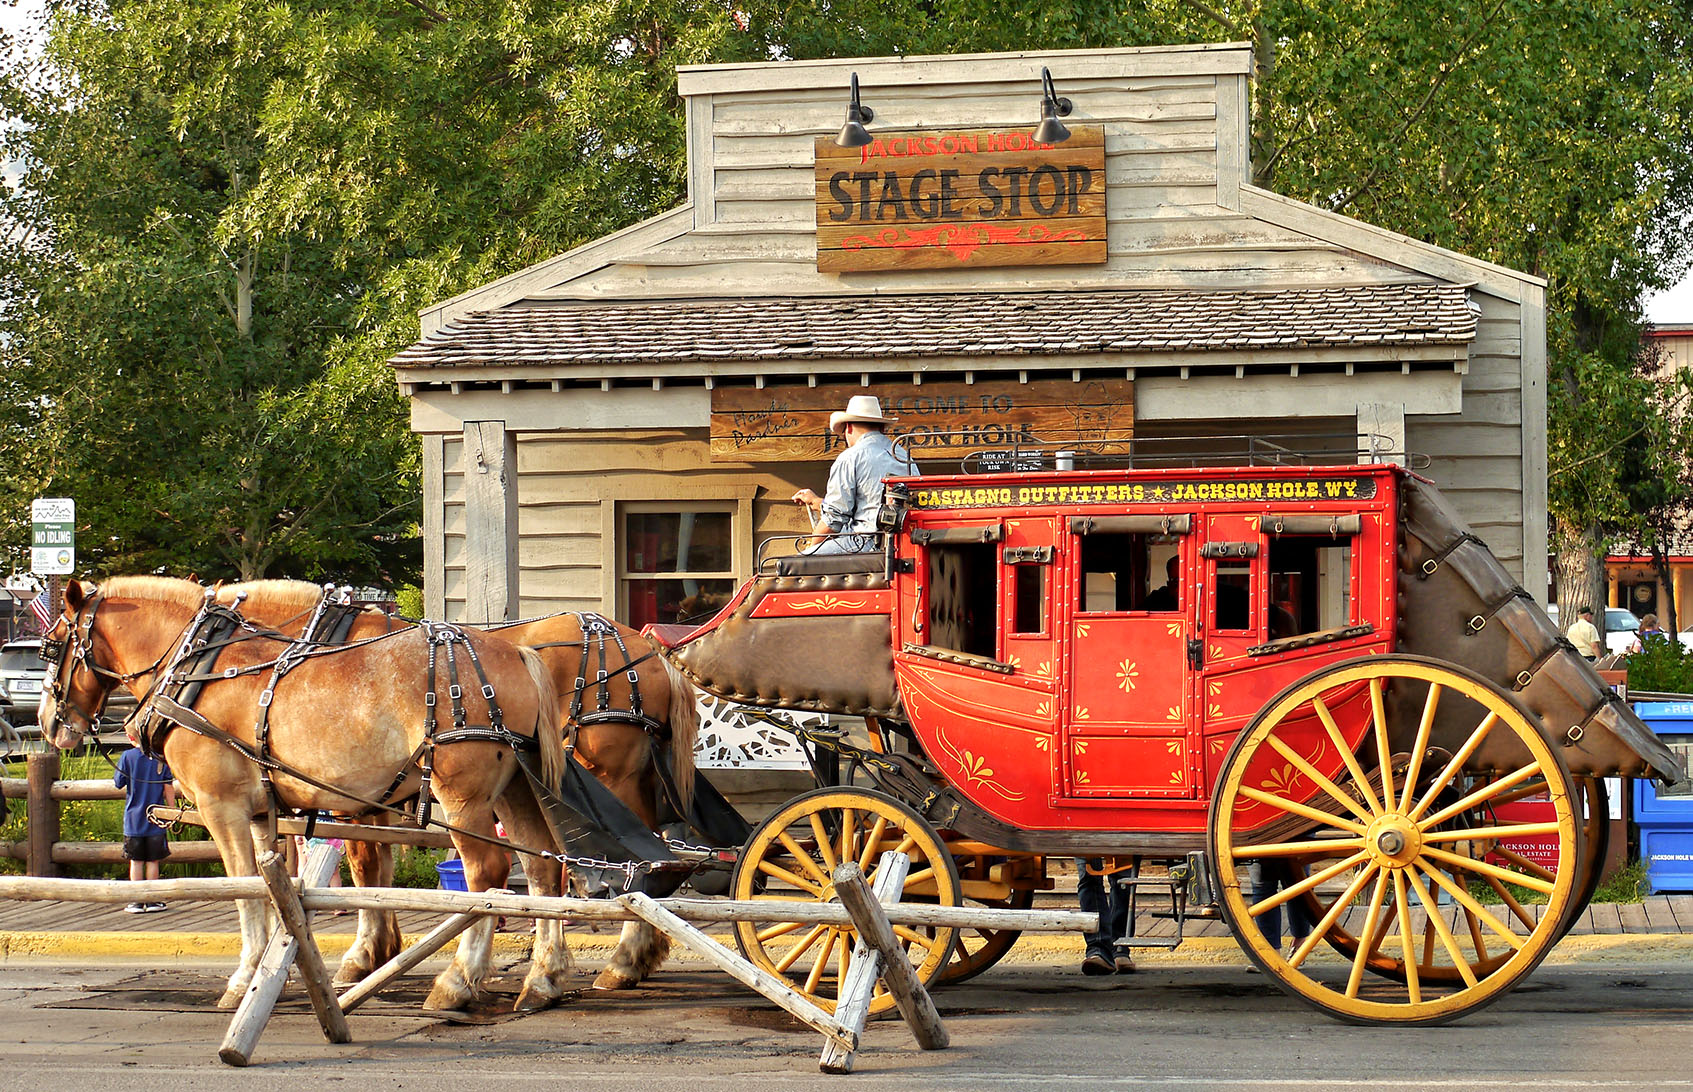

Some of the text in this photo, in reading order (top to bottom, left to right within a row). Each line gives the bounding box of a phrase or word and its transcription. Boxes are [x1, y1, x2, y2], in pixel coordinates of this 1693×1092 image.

[860, 134, 978, 165] JACKSON
[829, 165, 1092, 222] STAGE STOP
[881, 394, 1013, 417] LCOME TO
[917, 488, 1011, 506] CASTAGNO
[1019, 485, 1144, 502] OUTFITTERS
[1171, 483, 1263, 500] JACKSON
[1325, 481, 1357, 497] WY
[35, 531, 71, 544] NO IDLING
